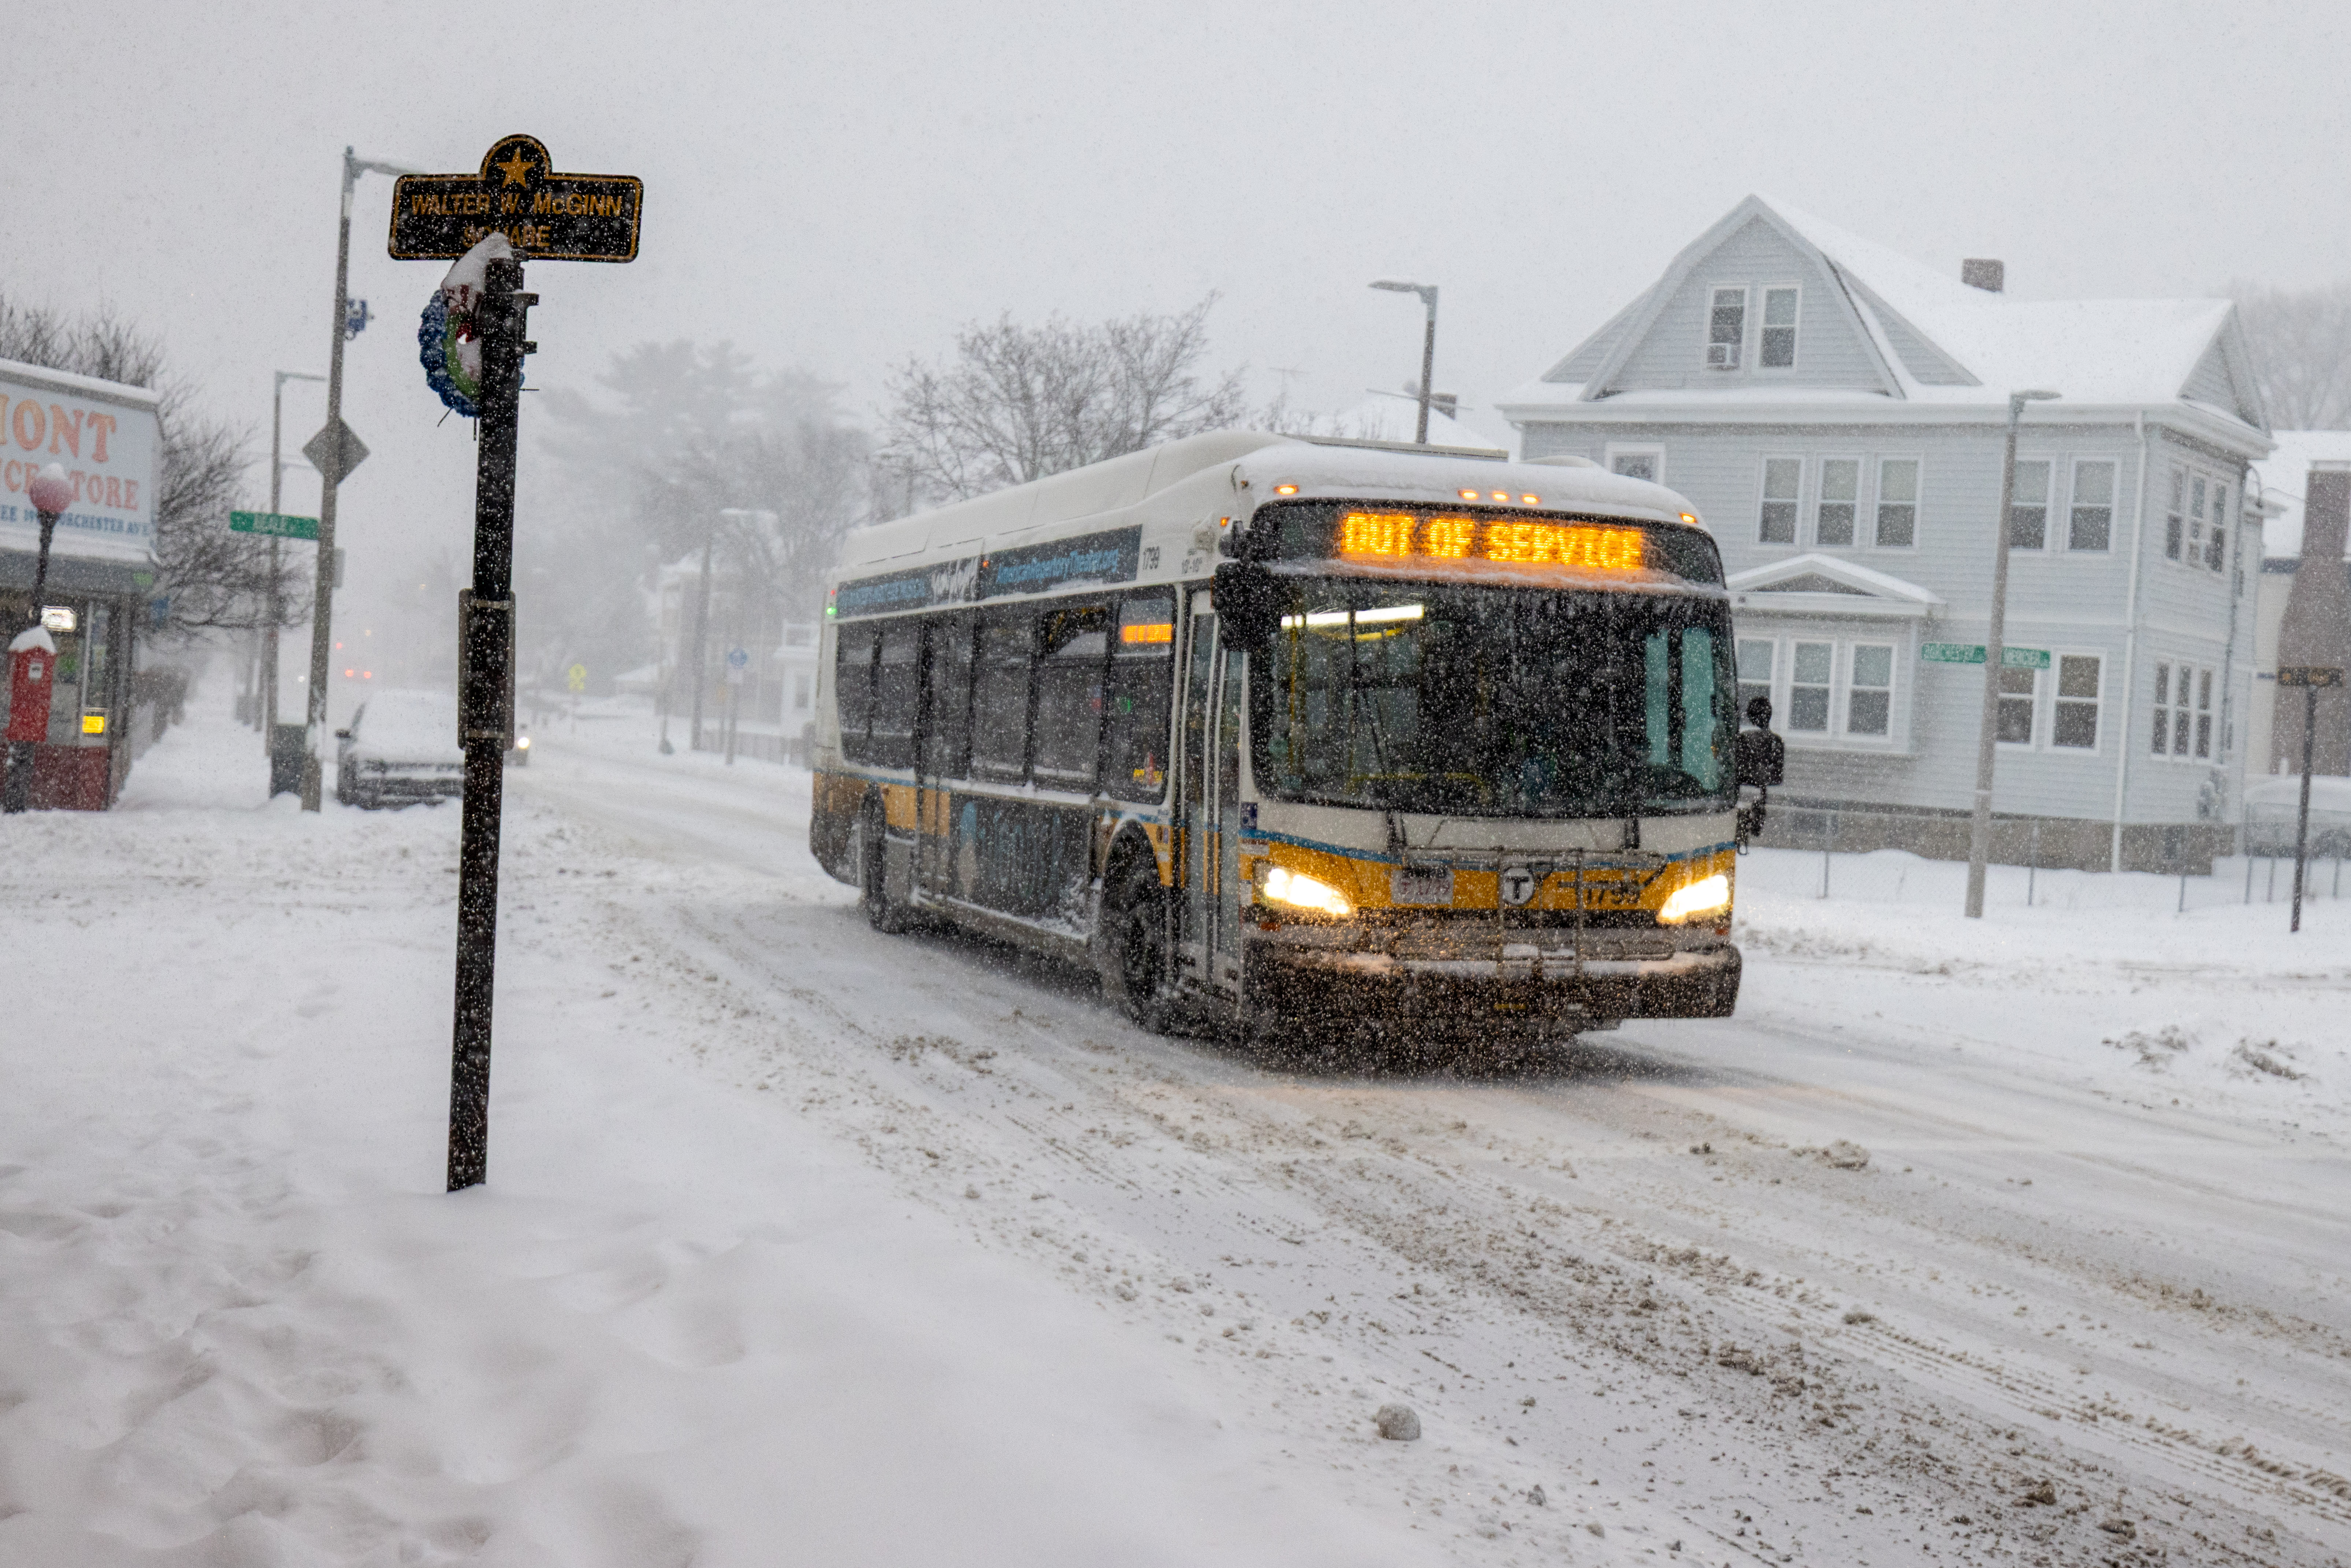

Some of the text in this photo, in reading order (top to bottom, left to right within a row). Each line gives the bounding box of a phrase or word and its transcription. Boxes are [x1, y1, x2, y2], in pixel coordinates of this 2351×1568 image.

[411, 193, 622, 216] WALTER W. McGINN
[463, 224, 551, 248] SQARE
[69, 469, 139, 511] TORE
[1344, 515, 1643, 571] OUT OF SERVICE
[1505, 876, 1530, 899] T
